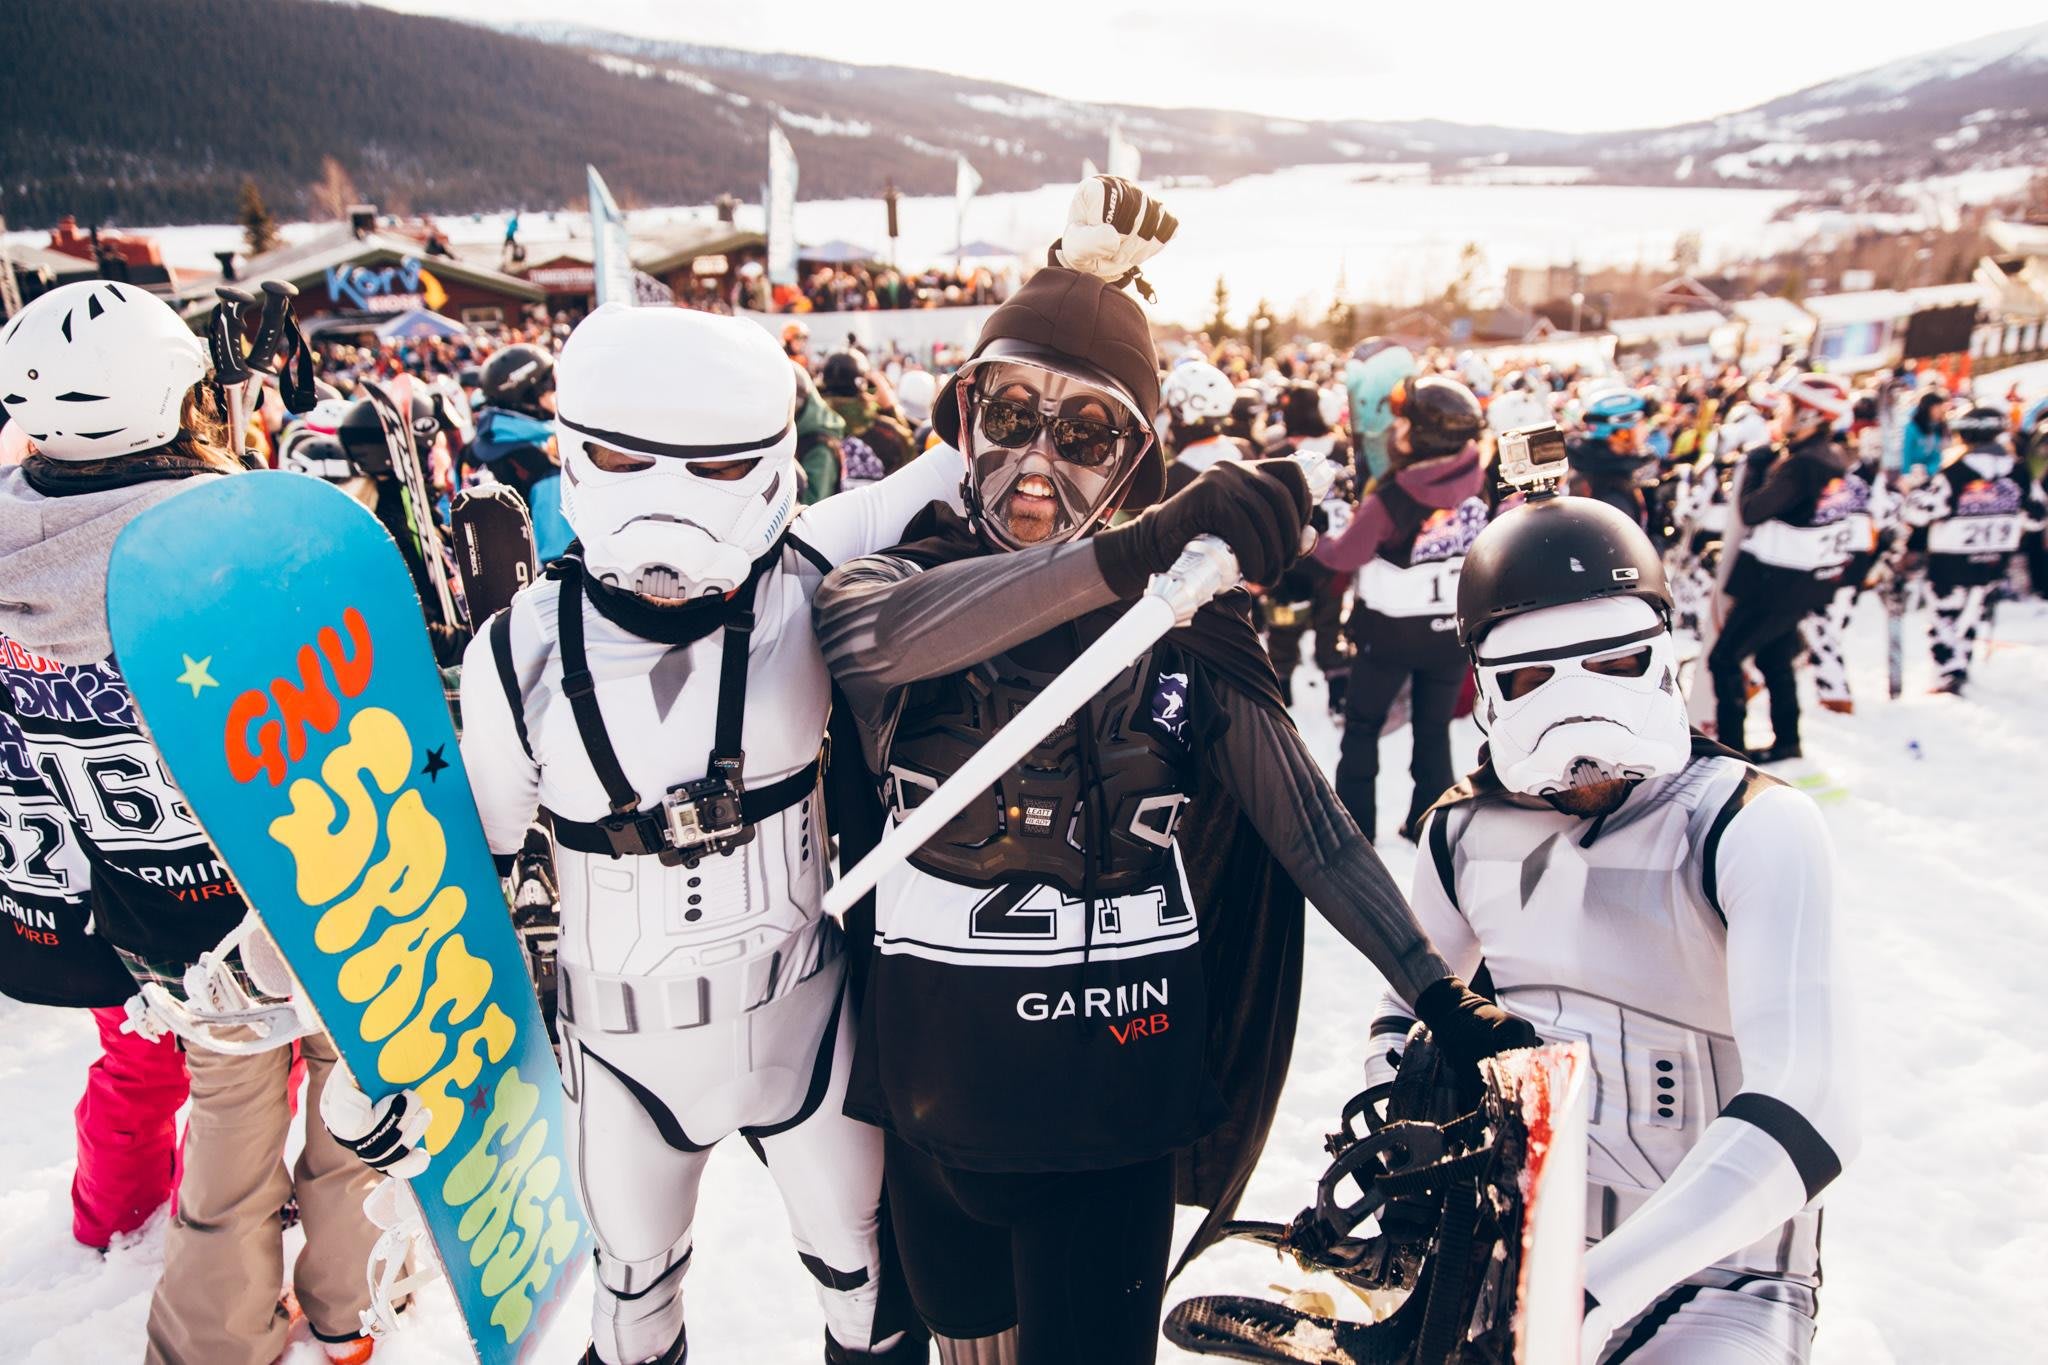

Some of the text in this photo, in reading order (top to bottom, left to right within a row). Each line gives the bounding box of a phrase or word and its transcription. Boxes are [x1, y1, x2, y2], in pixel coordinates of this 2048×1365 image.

[225, 607, 374, 786] GNU
[1026, 808, 1052, 817] LEATT
[13, 920, 60, 946] VIRB
[1016, 978, 1169, 1021] GARMIN
[268, 706, 580, 1344] SPACE CASE
